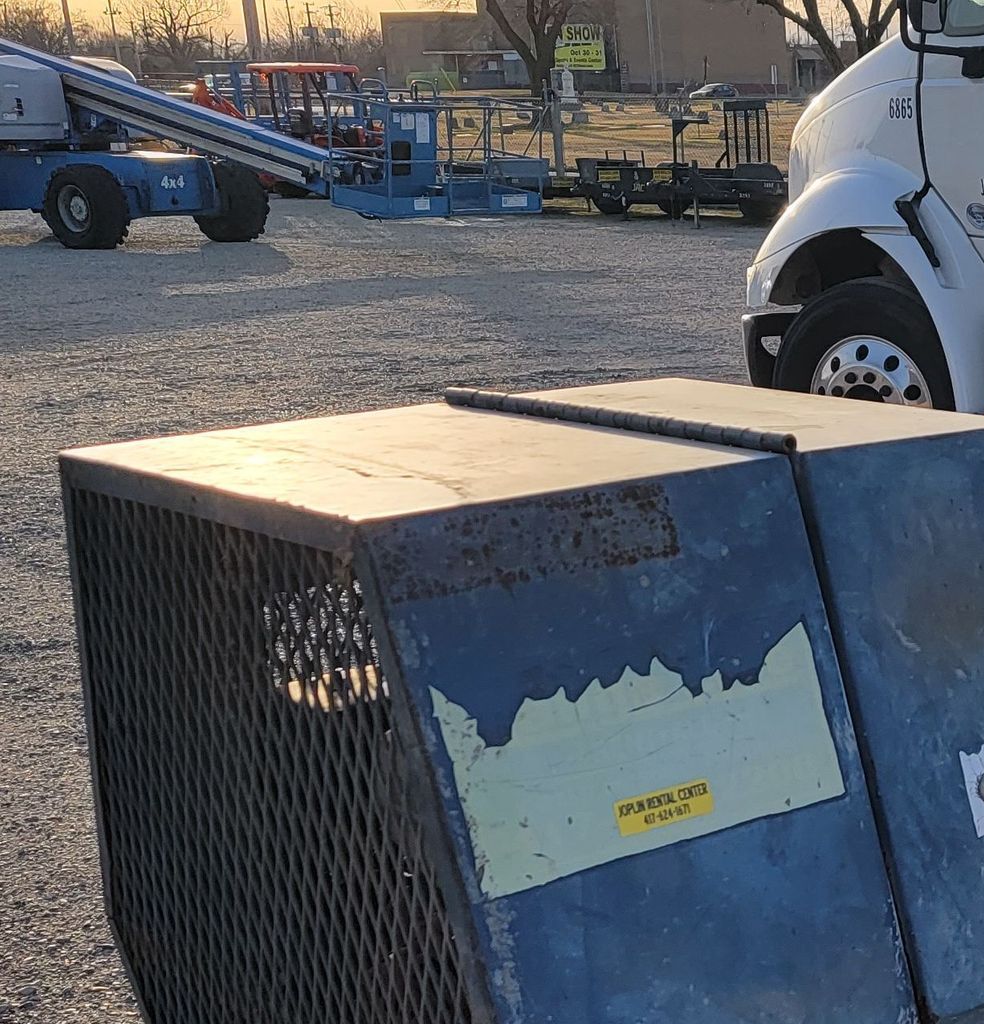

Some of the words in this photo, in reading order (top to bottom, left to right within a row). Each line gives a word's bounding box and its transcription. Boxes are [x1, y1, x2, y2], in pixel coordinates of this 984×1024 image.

[566, 25, 600, 40] SHOW
[889, 97, 913, 120] 6865
[160, 175, 185, 189] 4x4
[618, 799, 645, 818] JOPLIN
[646, 792, 677, 809] RENTAL
[677, 782, 708, 801] CENTER
